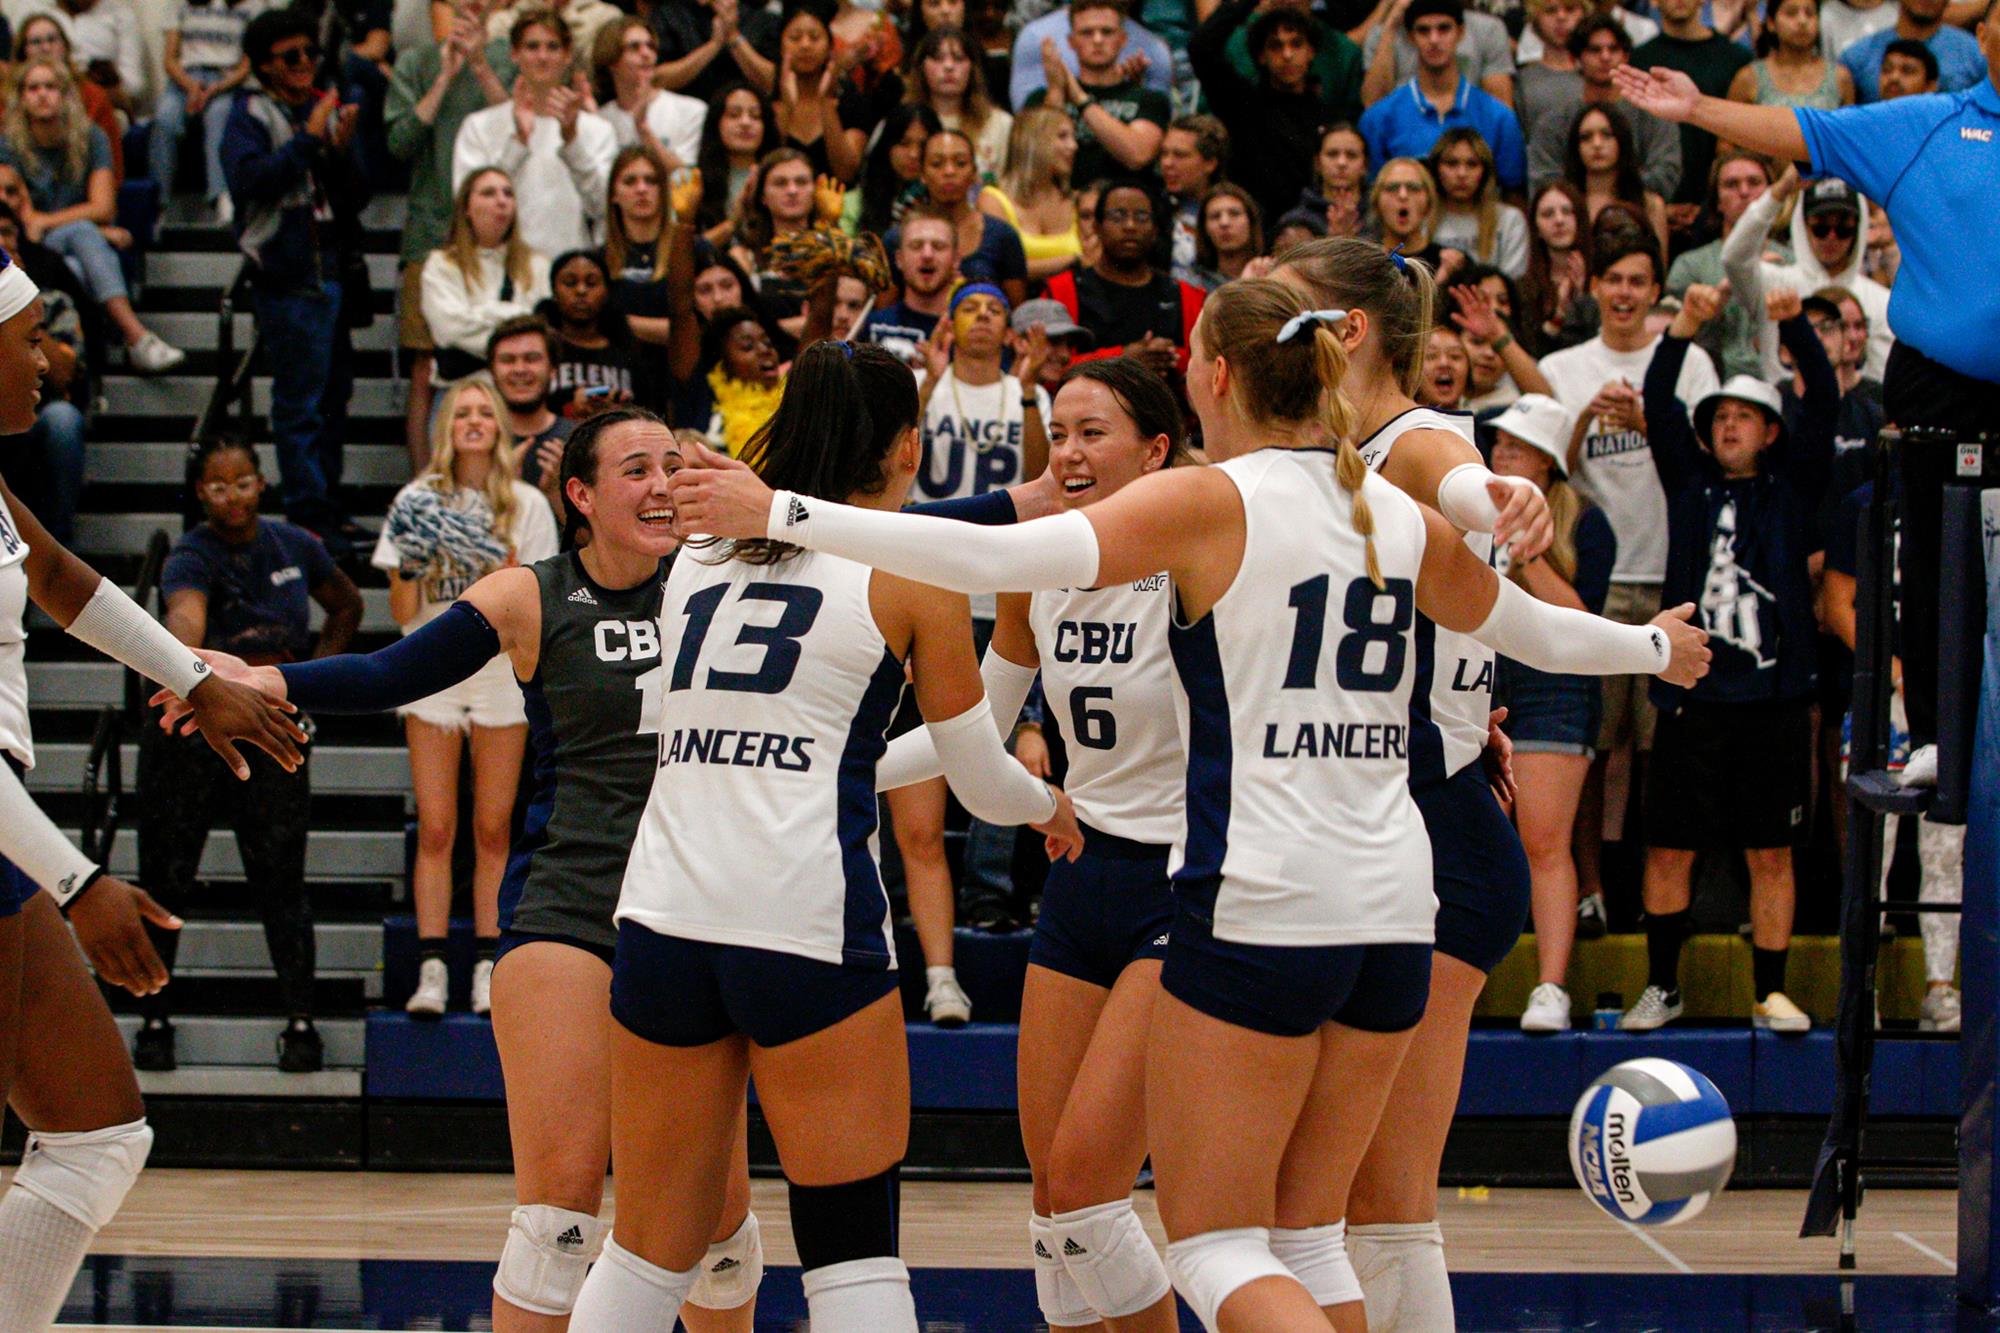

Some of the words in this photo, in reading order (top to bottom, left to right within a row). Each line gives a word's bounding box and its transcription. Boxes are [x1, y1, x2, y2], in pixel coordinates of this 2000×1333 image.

[1960, 127, 1993, 143] WAC
[924, 412, 1022, 445] LANCE
[918, 436, 1018, 499] UP
[567, 594, 598, 606] adidas
[593, 616, 661, 662] CB
[669, 582, 824, 695] 13
[1054, 620, 1138, 664] CBU
[1281, 573, 1414, 692] 18
[1069, 686, 1117, 750] 6
[659, 728, 815, 772] LANCERS
[1608, 1112, 1636, 1204] molten
